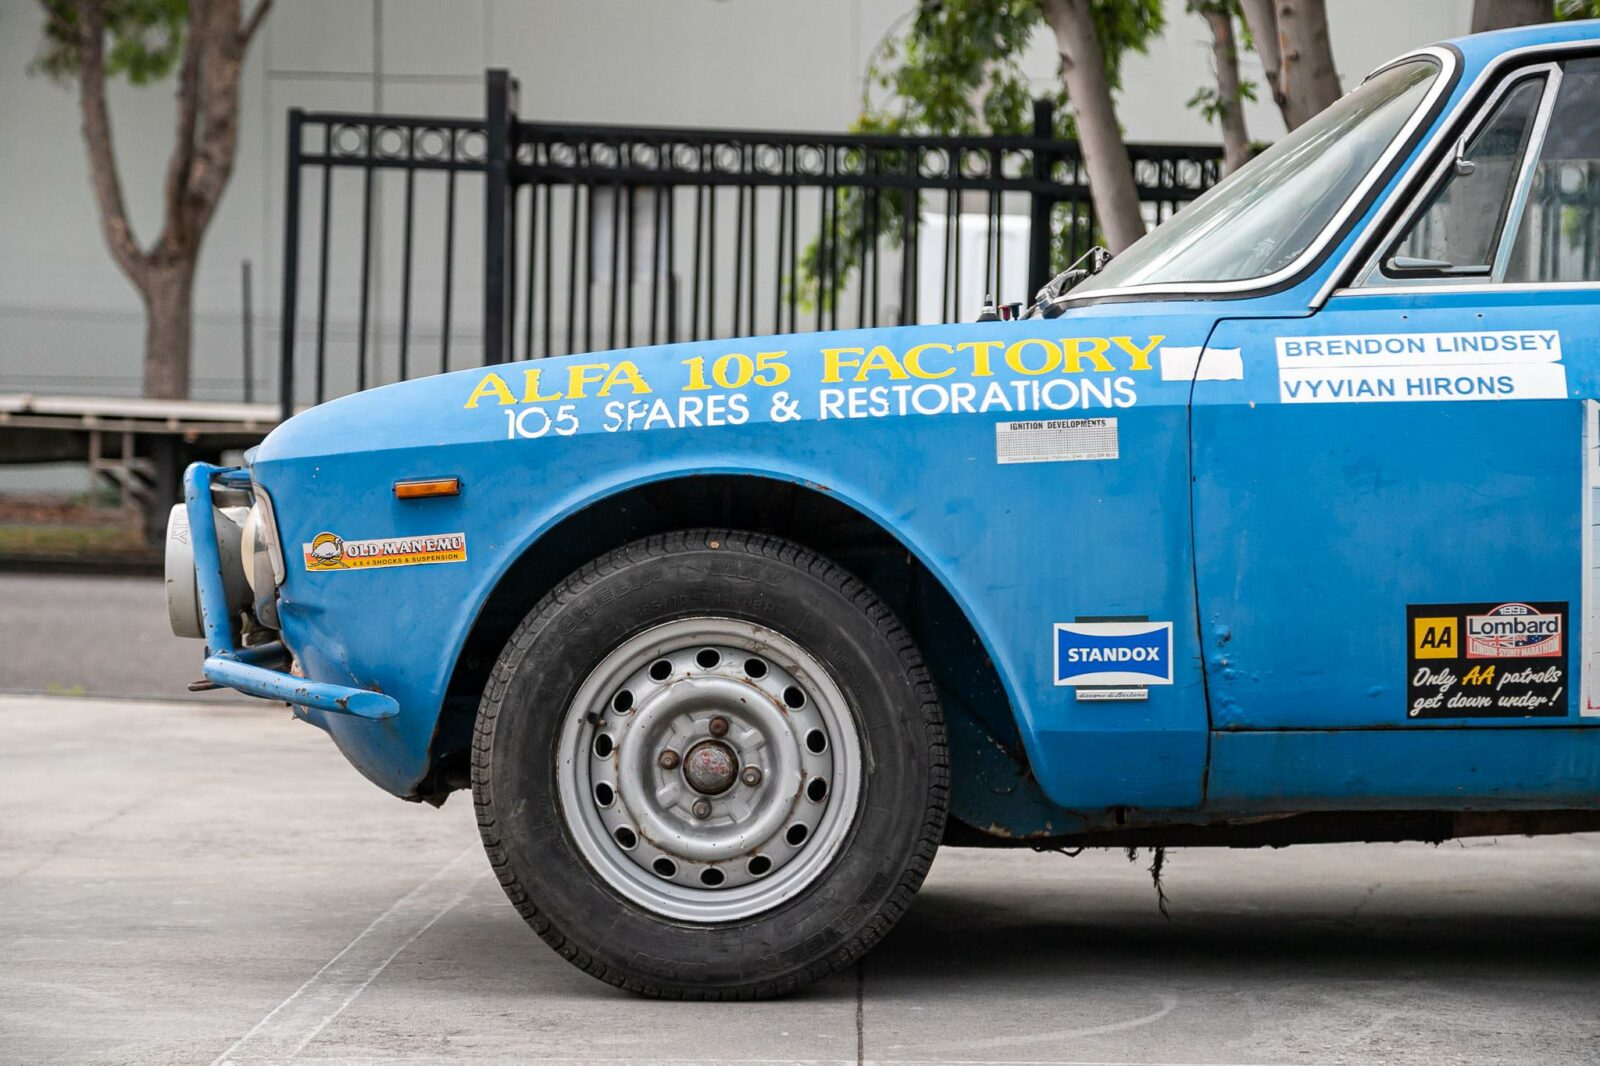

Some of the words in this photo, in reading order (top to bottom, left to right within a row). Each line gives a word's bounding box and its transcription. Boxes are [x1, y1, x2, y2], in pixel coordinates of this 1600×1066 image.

[1285, 337, 1425, 357] BRENDON
[1436, 334, 1557, 353] LINDSEY
[463, 360, 653, 409] ALFA
[681, 351, 791, 391] 105
[820, 335, 1166, 383] FACTORY
[1284, 377, 1395, 398] VYVIAN
[1406, 375, 1515, 396] HIRONS
[504, 404, 580, 440] 105
[603, 393, 750, 432] SPARES
[770, 390, 801, 423] &
[818, 376, 1138, 421] RESTORATIONS
[1010, 422, 1043, 431] IGNITION
[1047, 419, 1107, 429] DEVELOPMENTS
[347, 543, 380, 558] OLD
[383, 540, 423, 556] MAN
[425, 536, 463, 552] EMU
[412, 554, 459, 564] SUSPENSION
[1500, 606, 1528, 615] 1993
[1469, 616, 1559, 635] Lombard
[1420, 627, 1452, 648] AA
[1068, 647, 1160, 662] STANDOX
[1413, 667, 1458, 692] Only
[1462, 665, 1496, 686] AA
[1496, 666, 1562, 691] patrols
[1410, 693, 1445, 716] get
[1447, 692, 1492, 708] down
